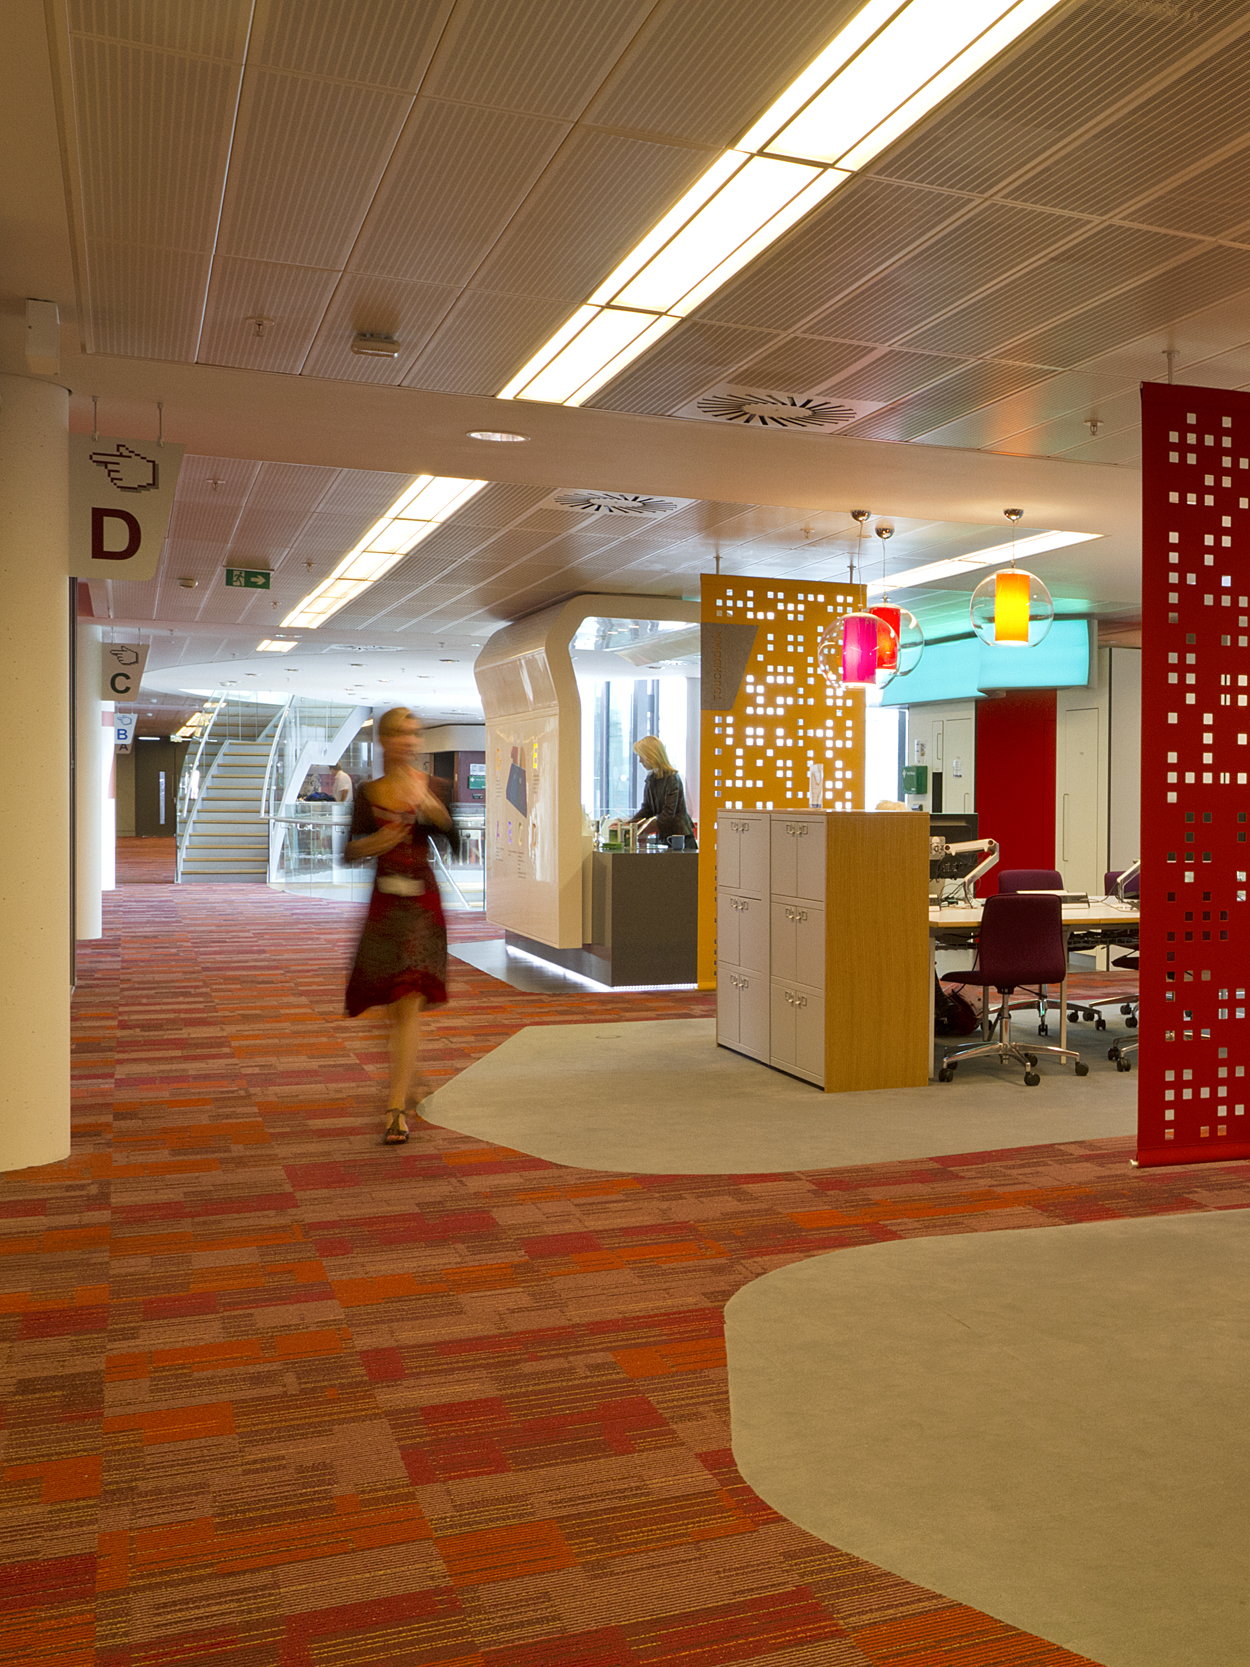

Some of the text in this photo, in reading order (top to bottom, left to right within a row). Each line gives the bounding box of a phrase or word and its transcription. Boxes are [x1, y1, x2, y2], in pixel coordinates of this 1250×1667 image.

[91, 507, 141, 560] D
[110, 672, 131, 694] C
[117, 728, 128, 740] B
